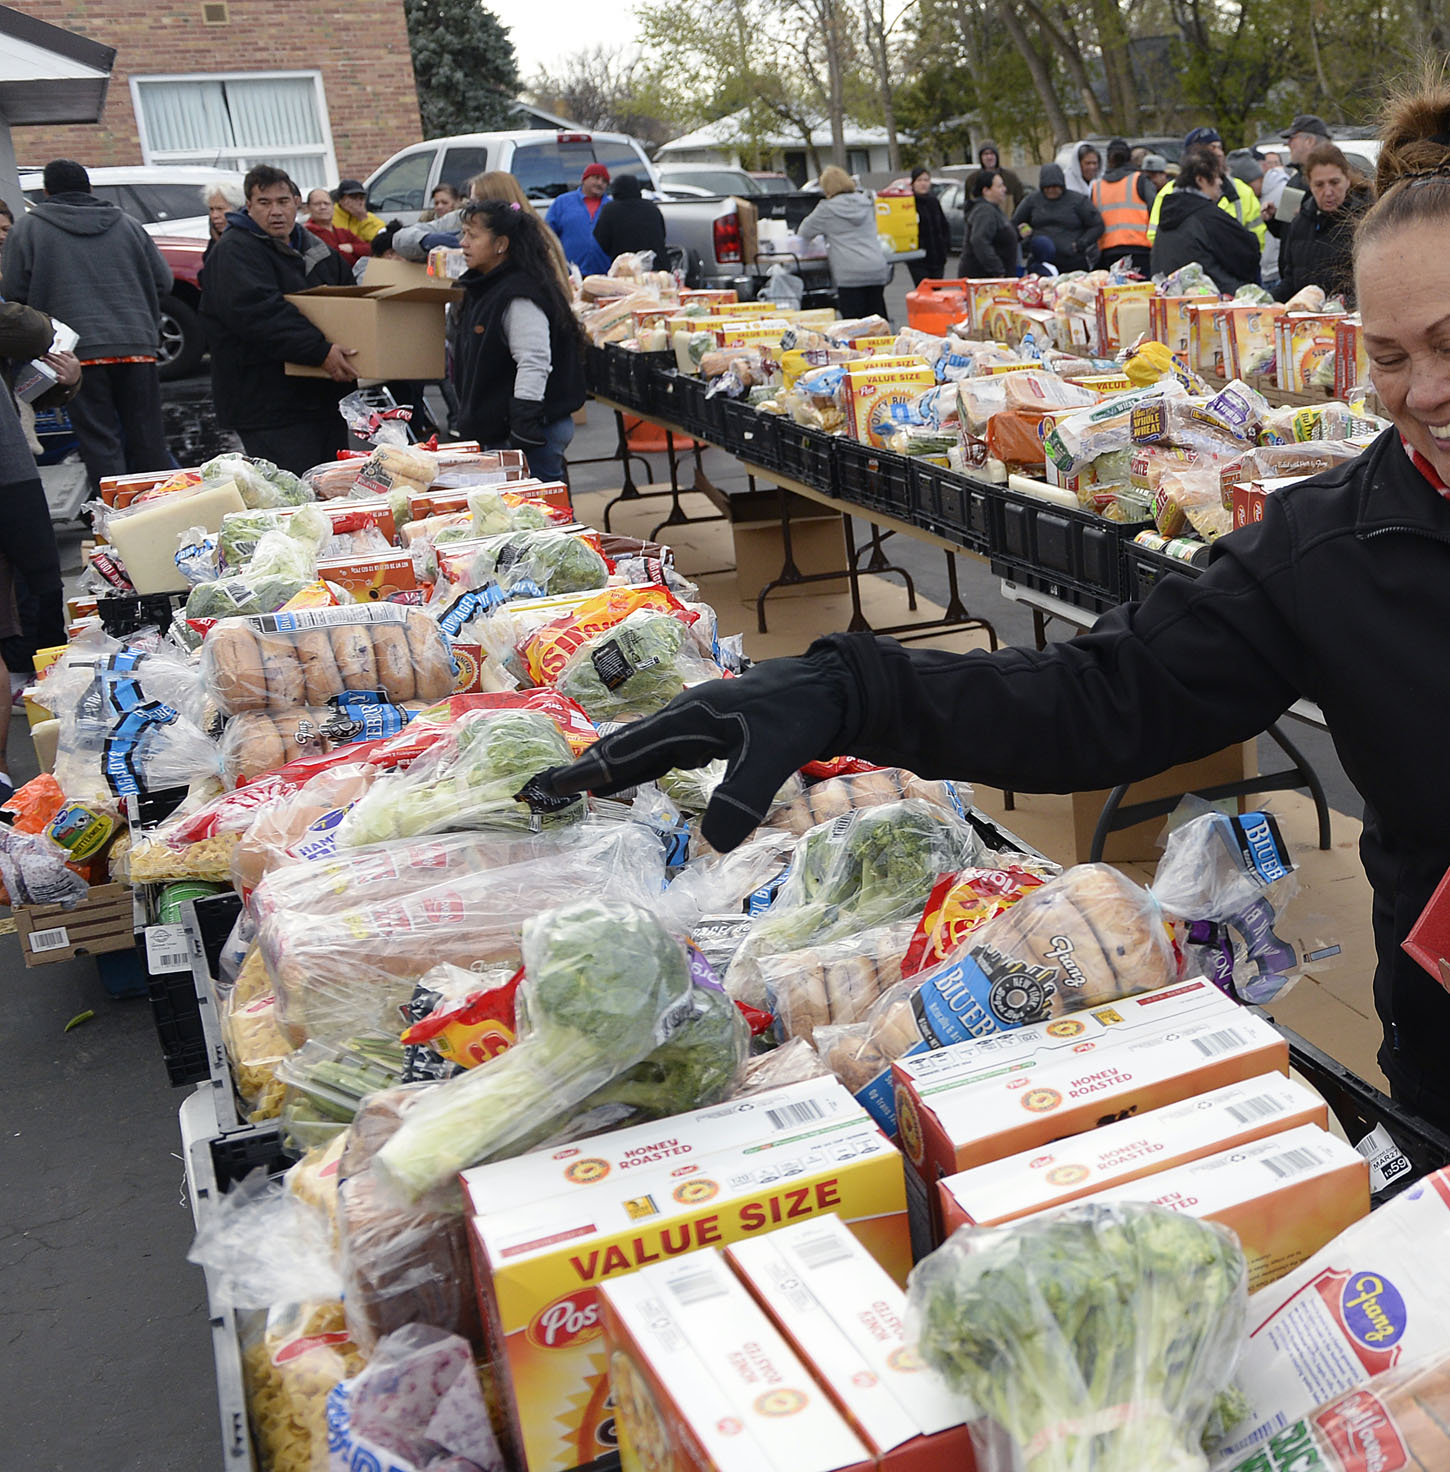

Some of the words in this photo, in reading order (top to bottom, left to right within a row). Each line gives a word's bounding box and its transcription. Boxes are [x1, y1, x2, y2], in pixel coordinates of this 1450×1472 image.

[859, 386, 877, 396] Post
[866, 375, 897, 384] VALUE
[899, 372, 922, 381] SIZE
[1097, 381, 1127, 391] VALUE
[1133, 414, 1160, 429] WHOLE
[1134, 424, 1161, 438] WHEAT
[1244, 820, 1285, 882] BLUEB
[1044, 934, 1088, 989] Franz
[932, 966, 1000, 1039] BLUEB
[1012, 976, 1031, 989] NEW
[1027, 981, 1043, 1011] YORK
[1068, 1072, 1134, 1099] ROASTED
[1070, 1066, 1119, 1088] HONEY
[618, 1143, 693, 1171] ROASTED
[624, 1138, 679, 1159] HONEY
[1096, 1142, 1166, 1171] ROASTED
[1098, 1138, 1150, 1161] HONEY
[1371, 1149, 1401, 1170] MAR27
[1151, 1191, 1182, 1207] NEY
[569, 1215, 723, 1282] VALUE
[738, 1178, 842, 1232] SIZE
[1345, 1275, 1396, 1343] Franz
[541, 1301, 600, 1345] Pos
[857, 1310, 891, 1342] HONEY
